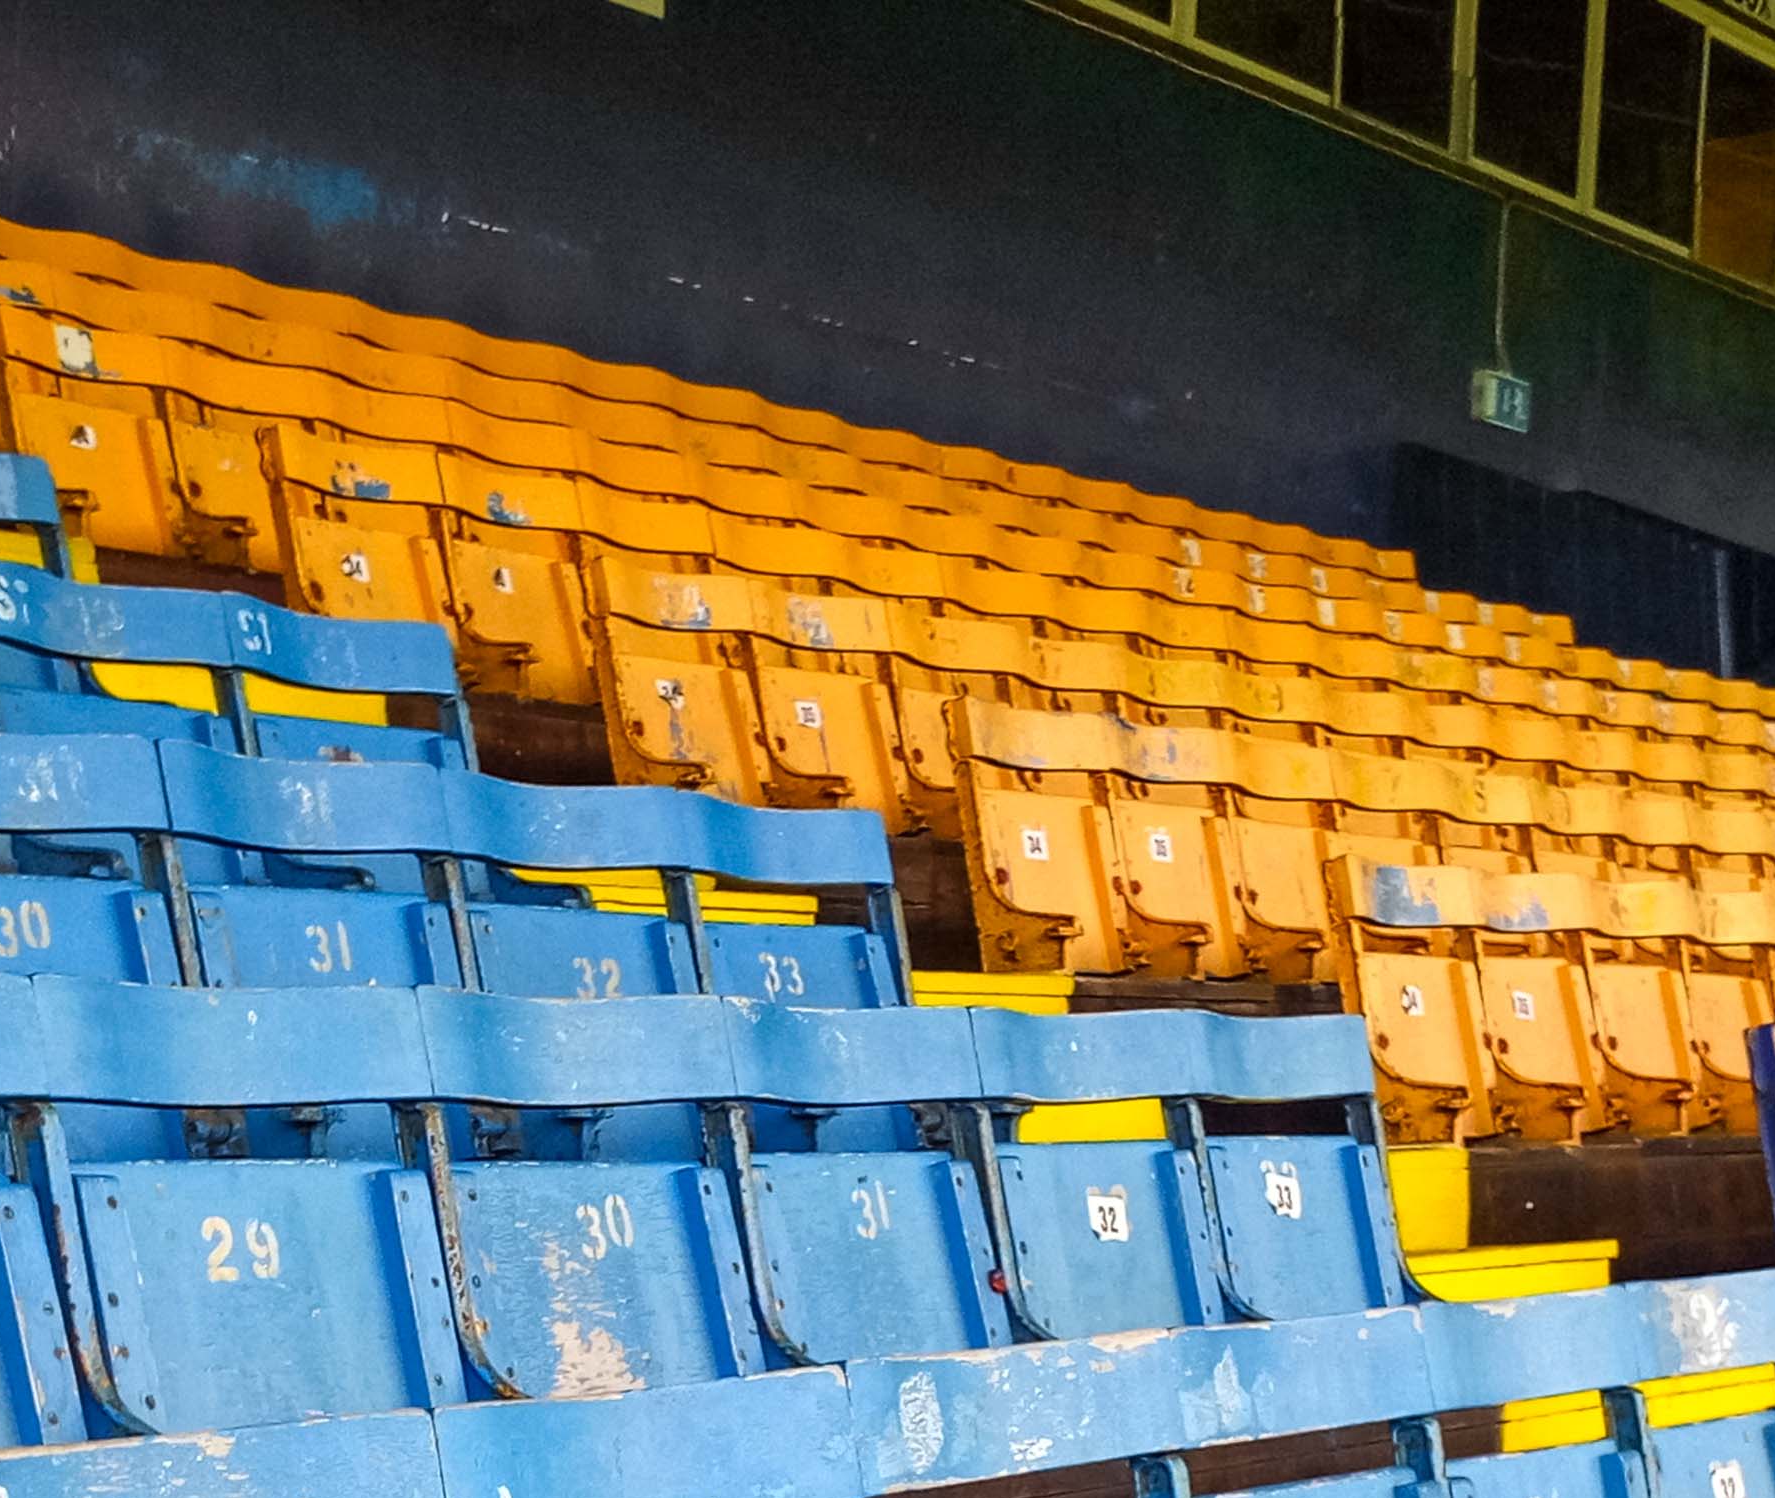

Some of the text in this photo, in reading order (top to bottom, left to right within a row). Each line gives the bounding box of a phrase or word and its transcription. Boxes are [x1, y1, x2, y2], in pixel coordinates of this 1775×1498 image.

[305, 921, 351, 973] 31
[573, 958, 625, 999] 32
[759, 952, 803, 998] 33
[852, 1180, 890, 1239] 31
[1098, 1206, 1120, 1234] 32
[1276, 1184, 1294, 1210] 33
[201, 1216, 279, 1282] 29
[576, 1195, 634, 1259] 30
